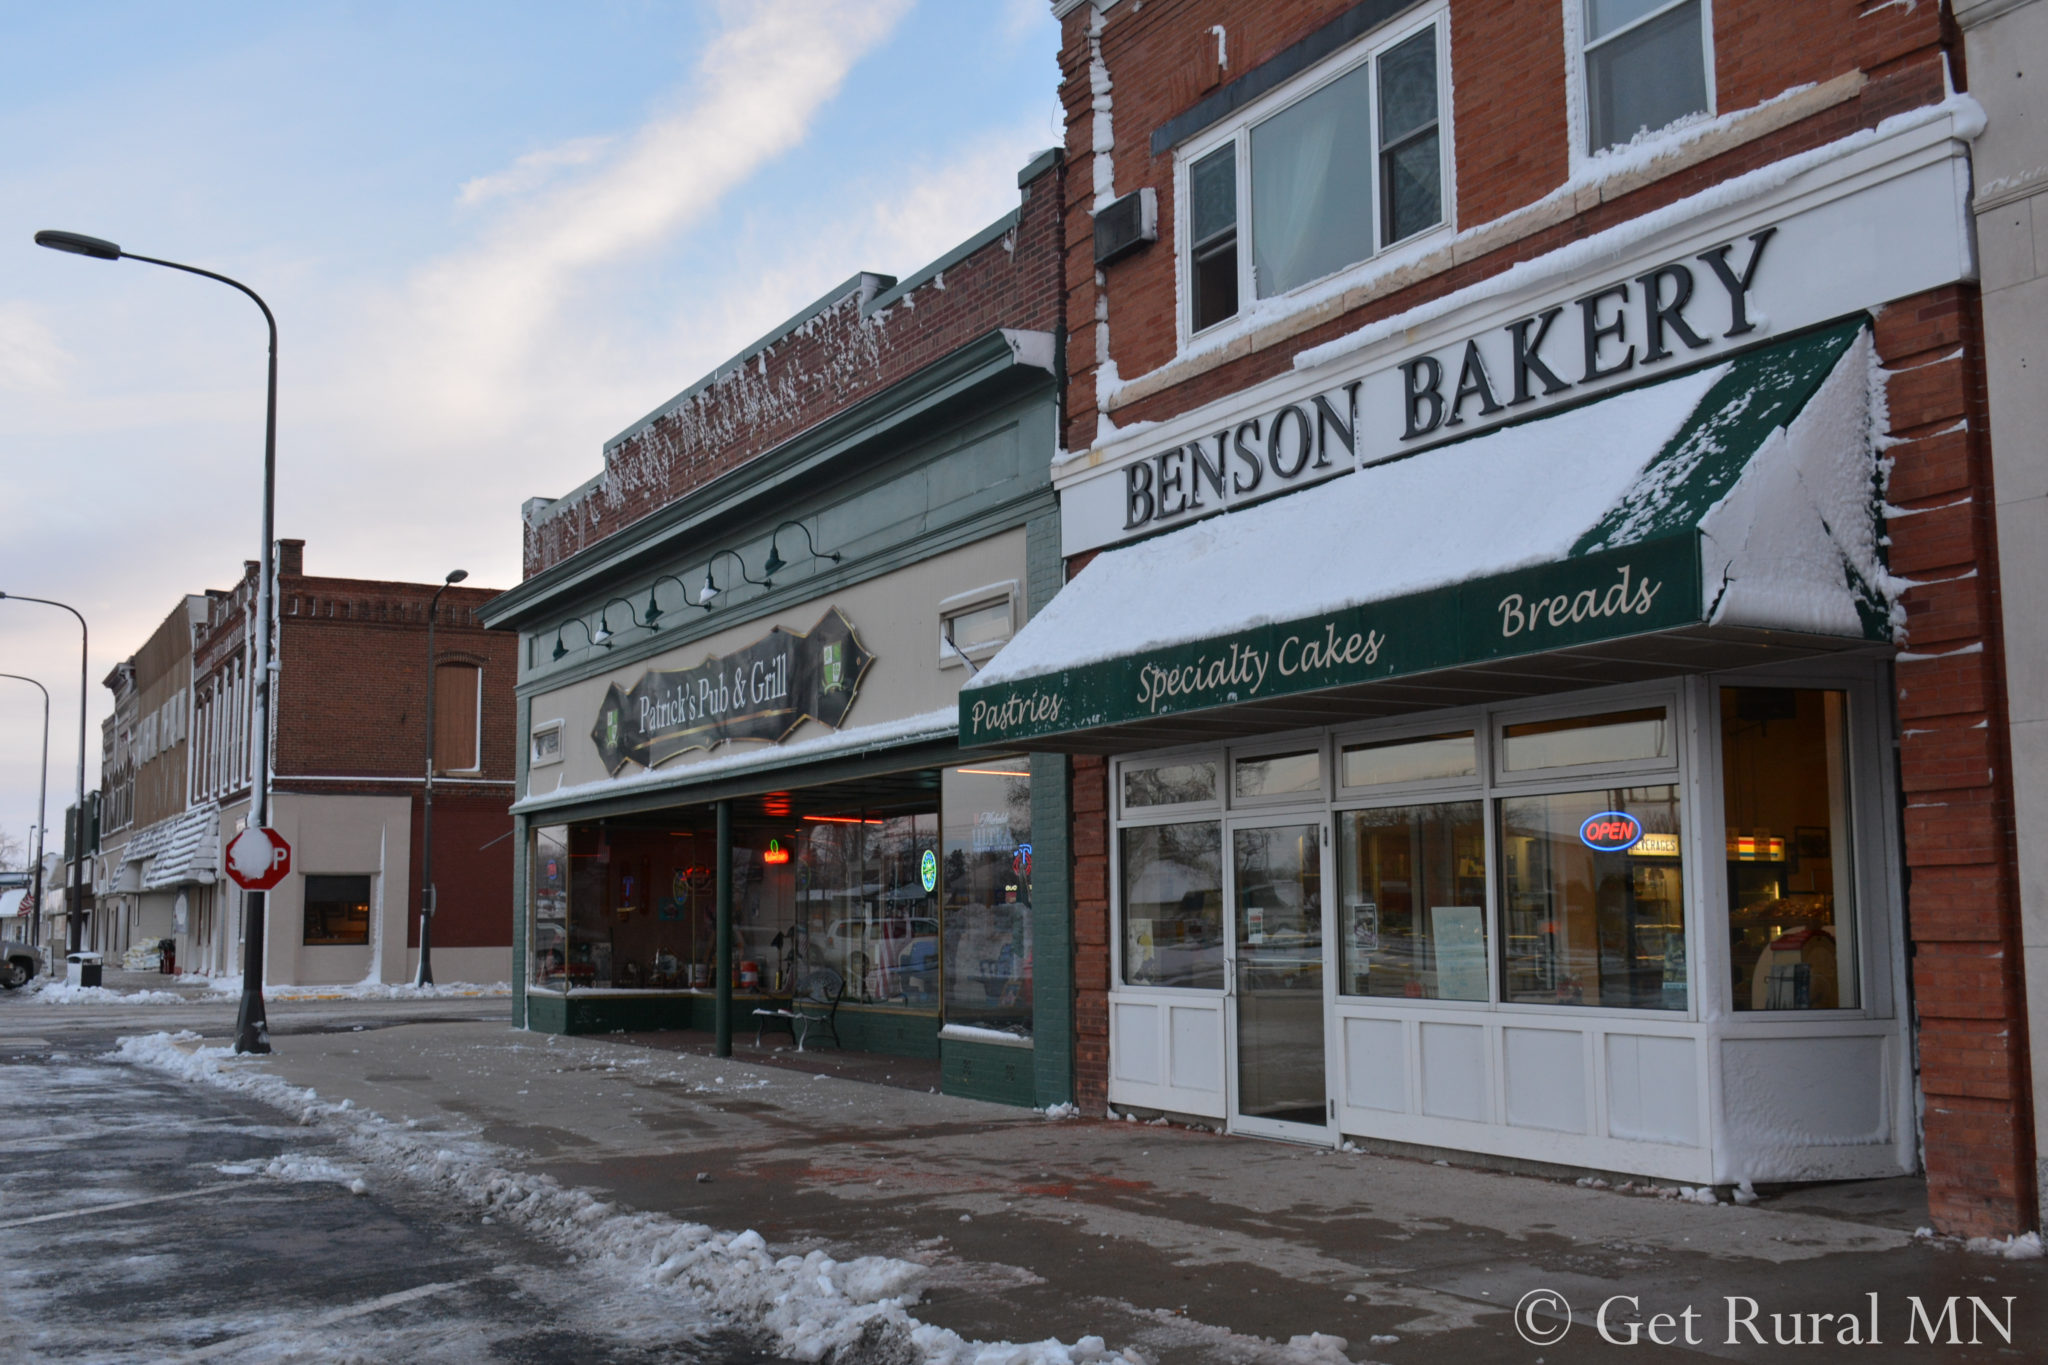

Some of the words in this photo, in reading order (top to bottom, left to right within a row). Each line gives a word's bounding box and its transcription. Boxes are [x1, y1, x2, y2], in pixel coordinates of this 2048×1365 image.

[1121, 381, 1363, 531] BENSON
[1397, 226, 1777, 441] BAKERY
[1498, 564, 1662, 637] Breads
[639, 682, 696, 734] Patrick's
[697, 672, 729, 719] Pub
[733, 666, 747, 710] &
[751, 652, 788, 704] Grill
[1137, 641, 1269, 713] Specialty
[1278, 622, 1386, 676] Cakes
[972, 689, 1063, 735] Pastries
[1586, 821, 1634, 841] OPEN
